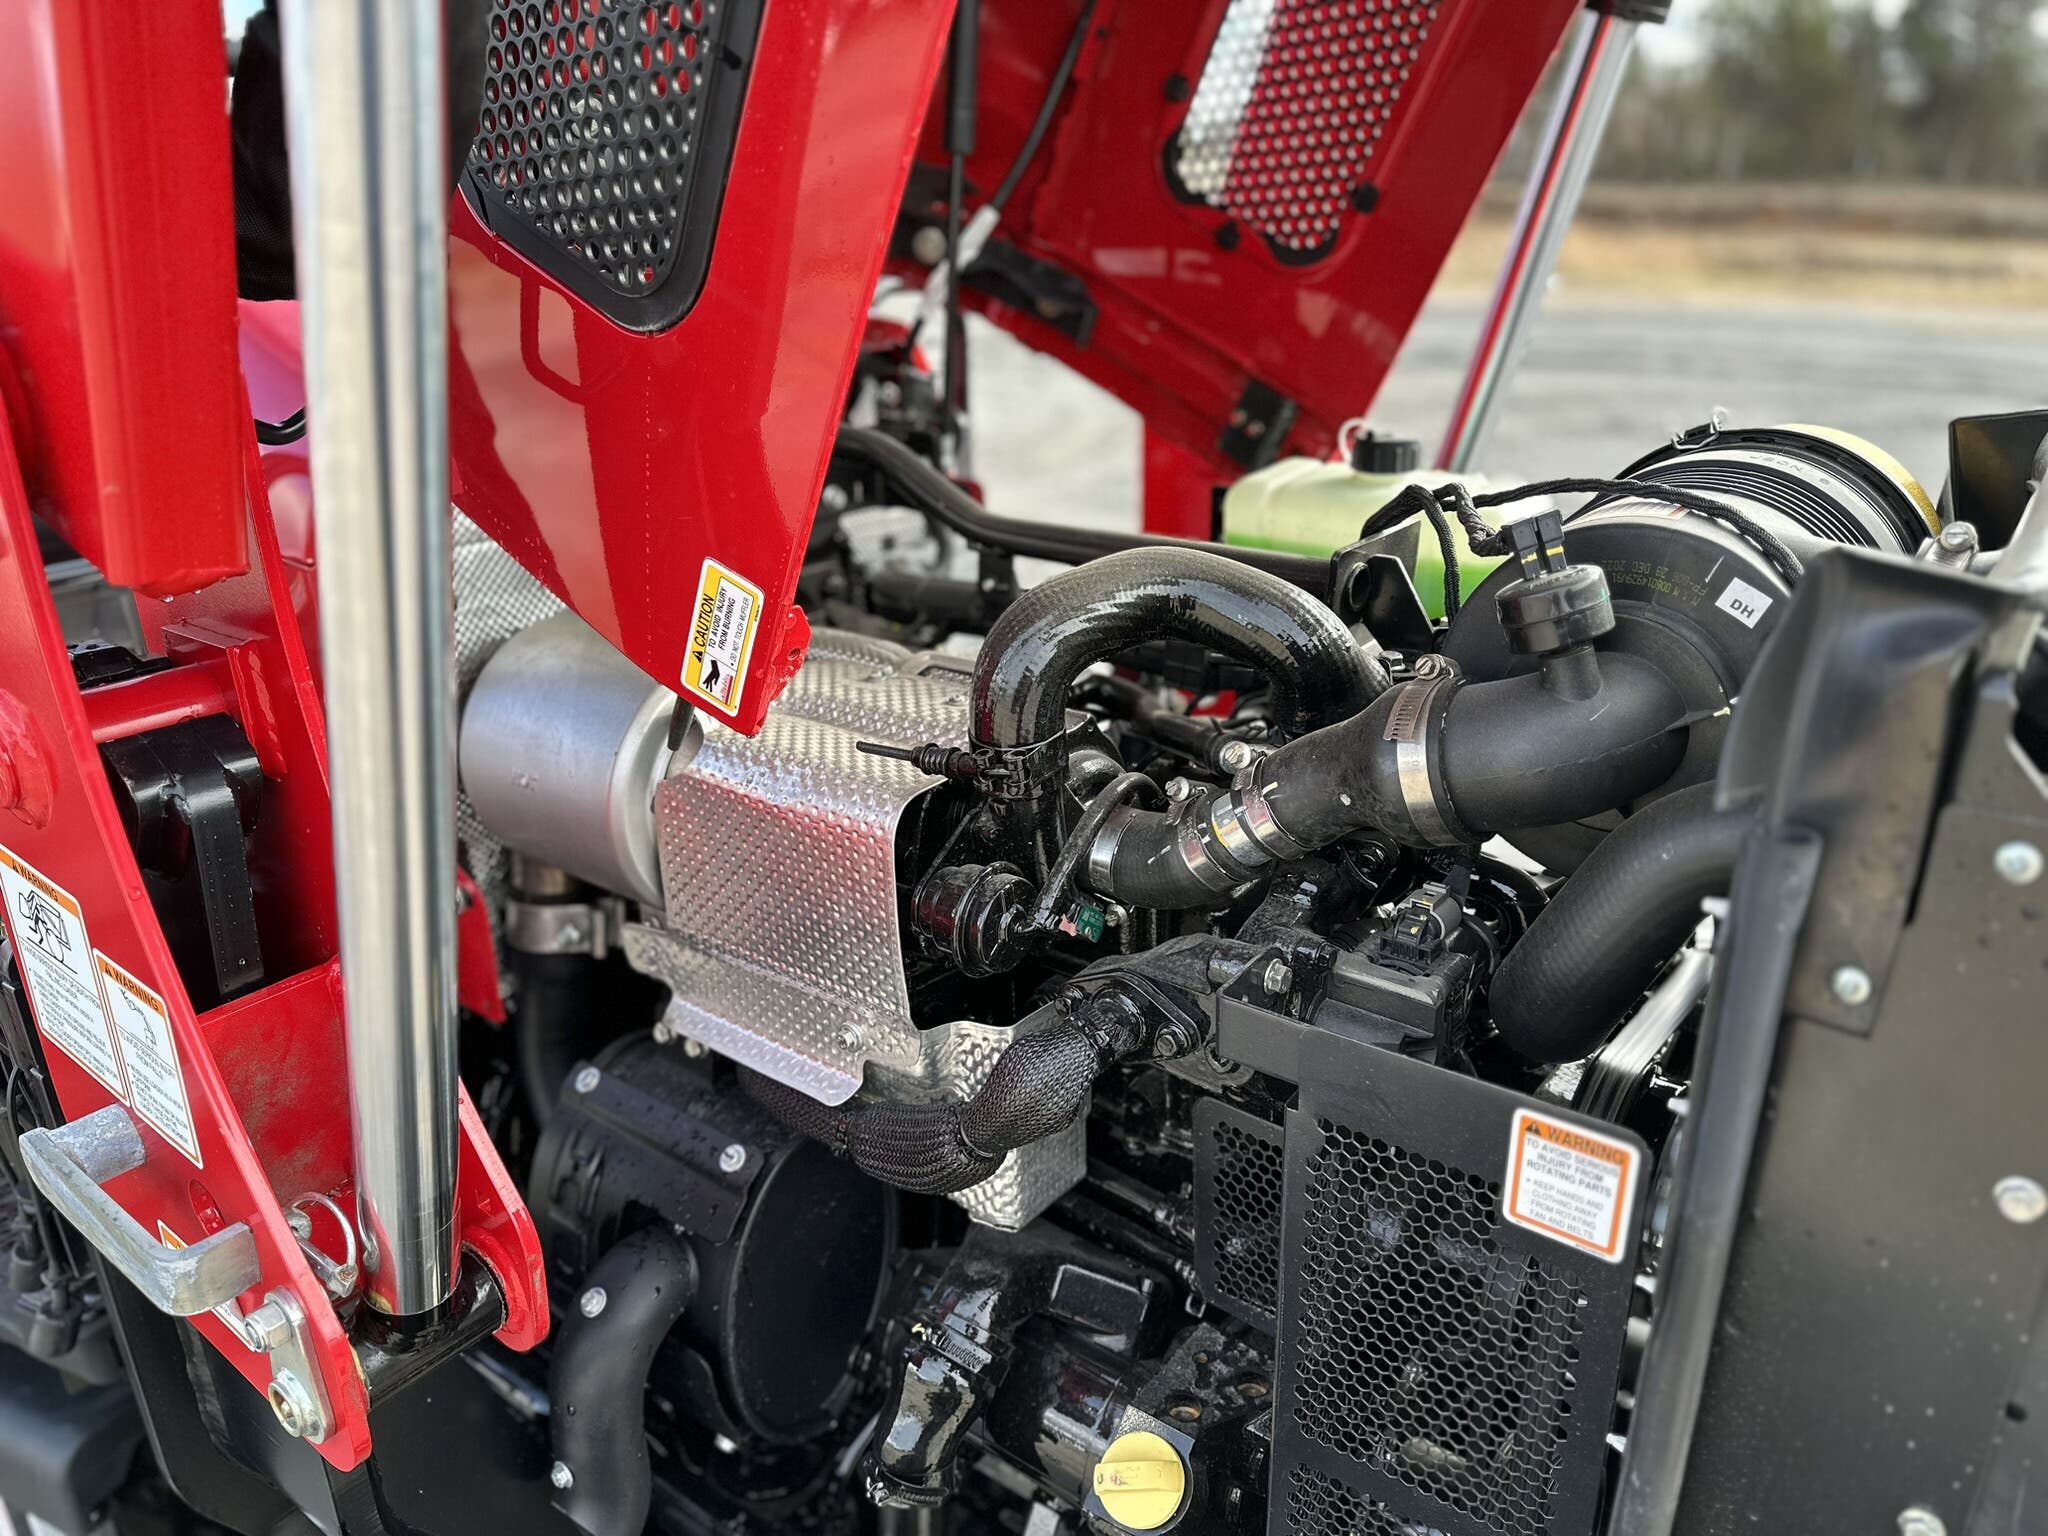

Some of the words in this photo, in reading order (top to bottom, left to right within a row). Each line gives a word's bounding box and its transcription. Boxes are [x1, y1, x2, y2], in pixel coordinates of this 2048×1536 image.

[716, 587, 727, 612] INJURY
[1730, 597, 1755, 619] DH
[696, 594, 714, 647] CAUTION
[712, 614, 721, 637] AVOID
[718, 629, 728, 651] FROM
[723, 598, 735, 629] BURNING
[730, 652, 736, 661] DO
[735, 622, 744, 640] TOUCH
[740, 597, 749, 621] MUFFLER
[709, 639, 715, 648] TO
[19, 866, 59, 902] WARNING
[113, 972, 159, 1010] WARNING
[1527, 1139, 1539, 1149] TO
[1543, 1144, 1571, 1161] AVOID
[1574, 1155, 1619, 1177] SERIOUS
[1548, 1126, 1624, 1164] WARNING
[1527, 1160, 1576, 1184] ROTATING
[1578, 1179, 1612, 1197] PARTS
[1537, 1154, 1571, 1171] INJURY
[1575, 1166, 1604, 1182] FROM
[1532, 1190, 1572, 1210] CLOTHING
[1574, 1205, 1598, 1218] AWAY
[1533, 1180, 1555, 1193] KEEP
[1556, 1186, 1584, 1203] HANDS
[1587, 1199, 1604, 1210] AND
[1530, 1210, 1546, 1220] FAN
[1548, 1216, 1565, 1228] AND
[1567, 1224, 1594, 1240] BELTS
[1531, 1200, 1555, 1213] FROM
[1555, 1209, 1596, 1229] ROTATING
